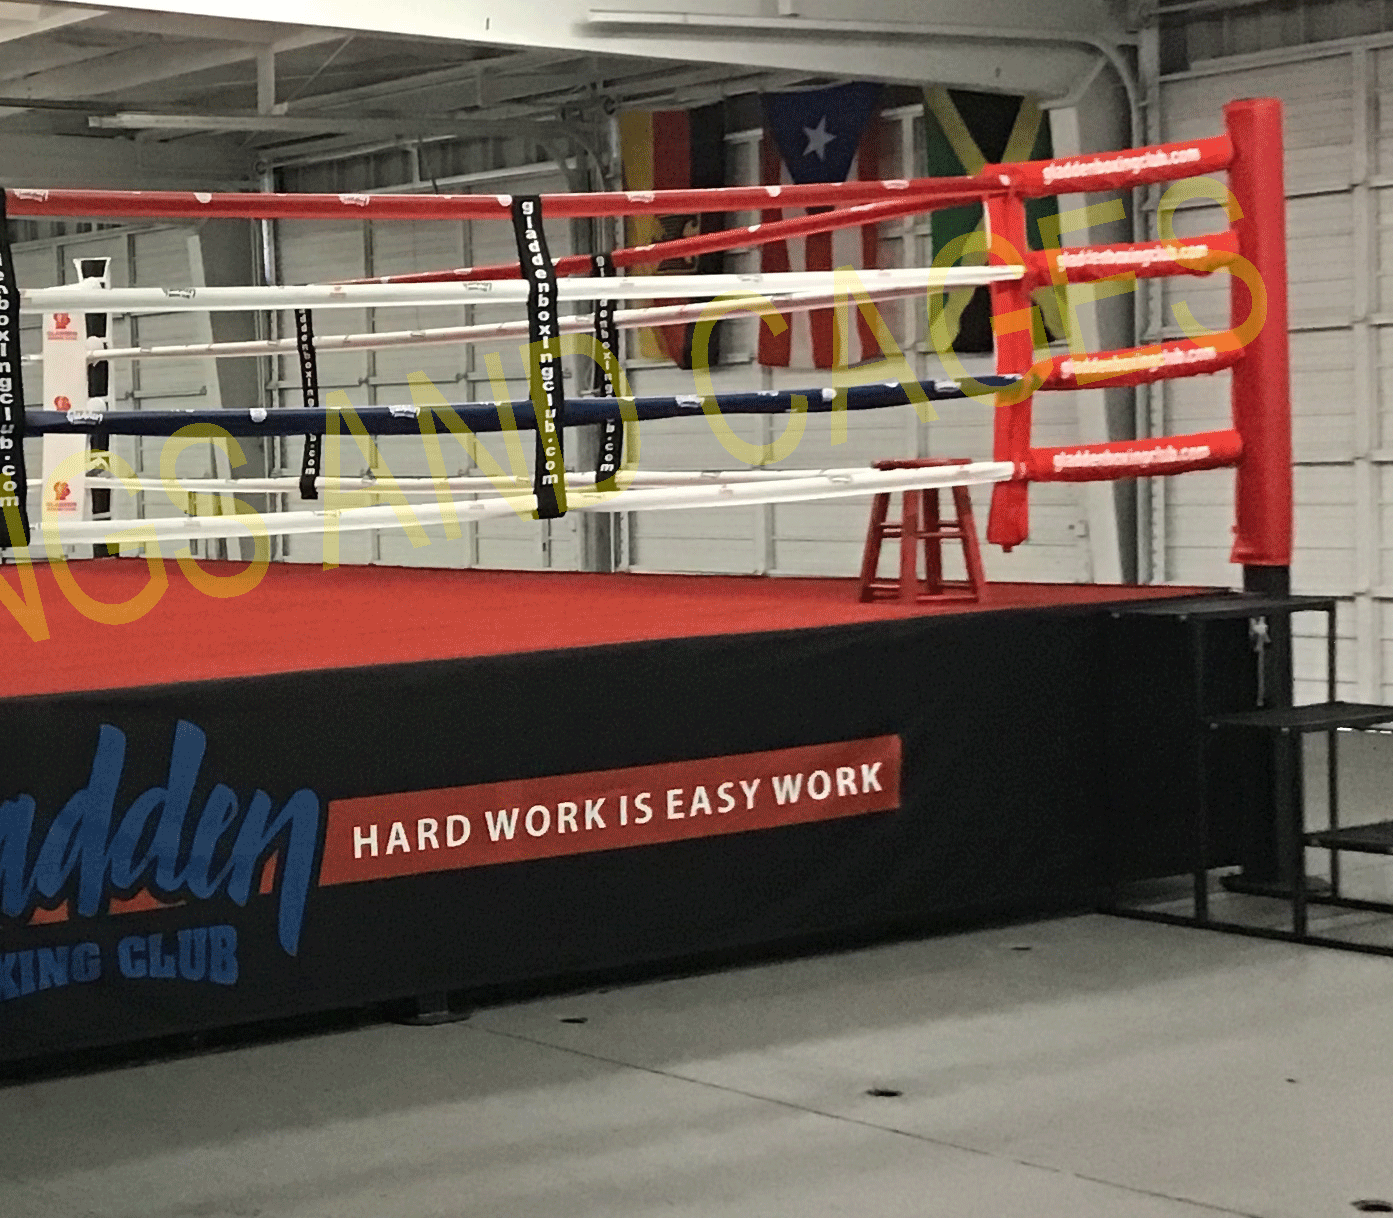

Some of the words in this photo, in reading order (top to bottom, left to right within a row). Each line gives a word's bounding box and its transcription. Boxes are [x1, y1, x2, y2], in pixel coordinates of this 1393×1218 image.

[521, 200, 559, 486] gladdenboxingclub.com
[353, 814, 472, 859] HARD
[485, 797, 607, 842] WORK
[619, 792, 653, 826] IS
[667, 779, 762, 820] EASY
[772, 762, 884, 807] WORK
[118, 925, 239, 986] CLUB
